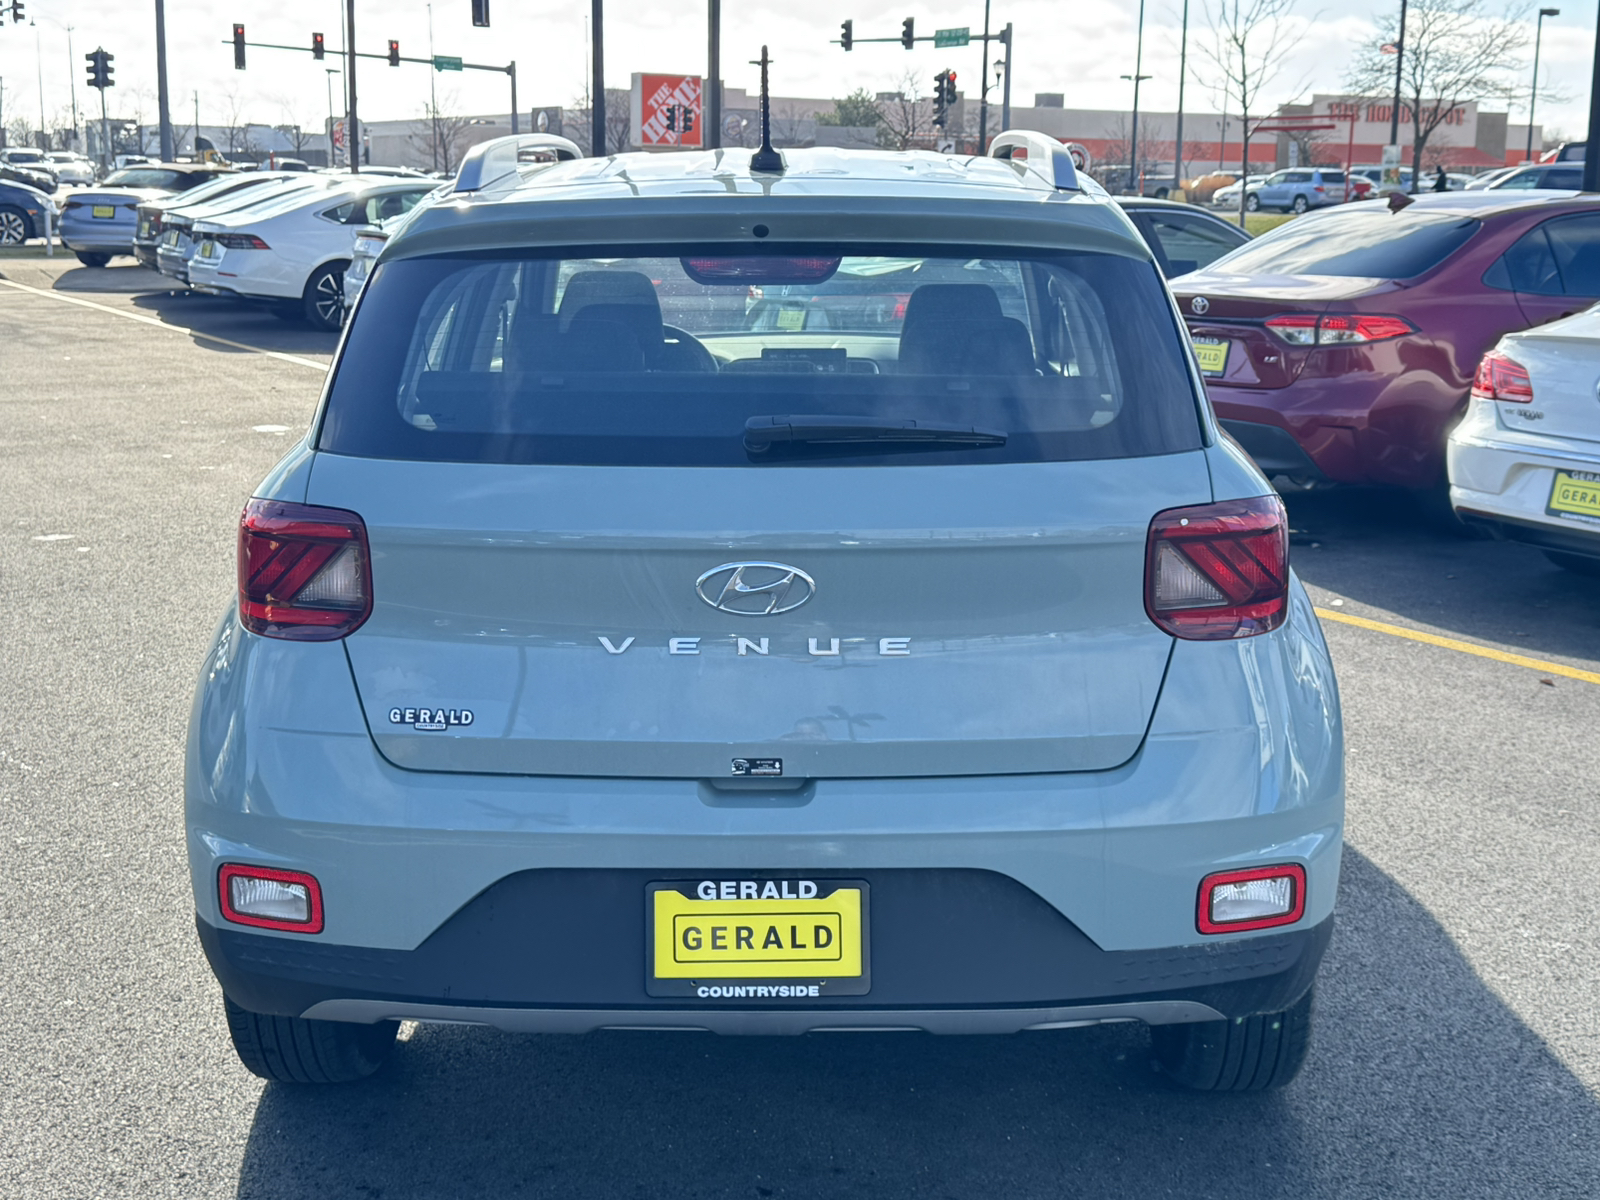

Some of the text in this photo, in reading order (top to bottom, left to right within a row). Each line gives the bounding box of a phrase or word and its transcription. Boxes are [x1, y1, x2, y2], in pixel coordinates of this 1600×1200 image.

[647, 82, 673, 110] THE
[1571, 471, 1600, 483] GERA
[1561, 489, 1600, 505] GERA
[598, 636, 911, 656] VENUE
[389, 708, 474, 725] GERALD
[697, 880, 818, 901] GERALD
[681, 925, 833, 951] GERALD
[696, 985, 820, 998] COUNTRYSIDE
